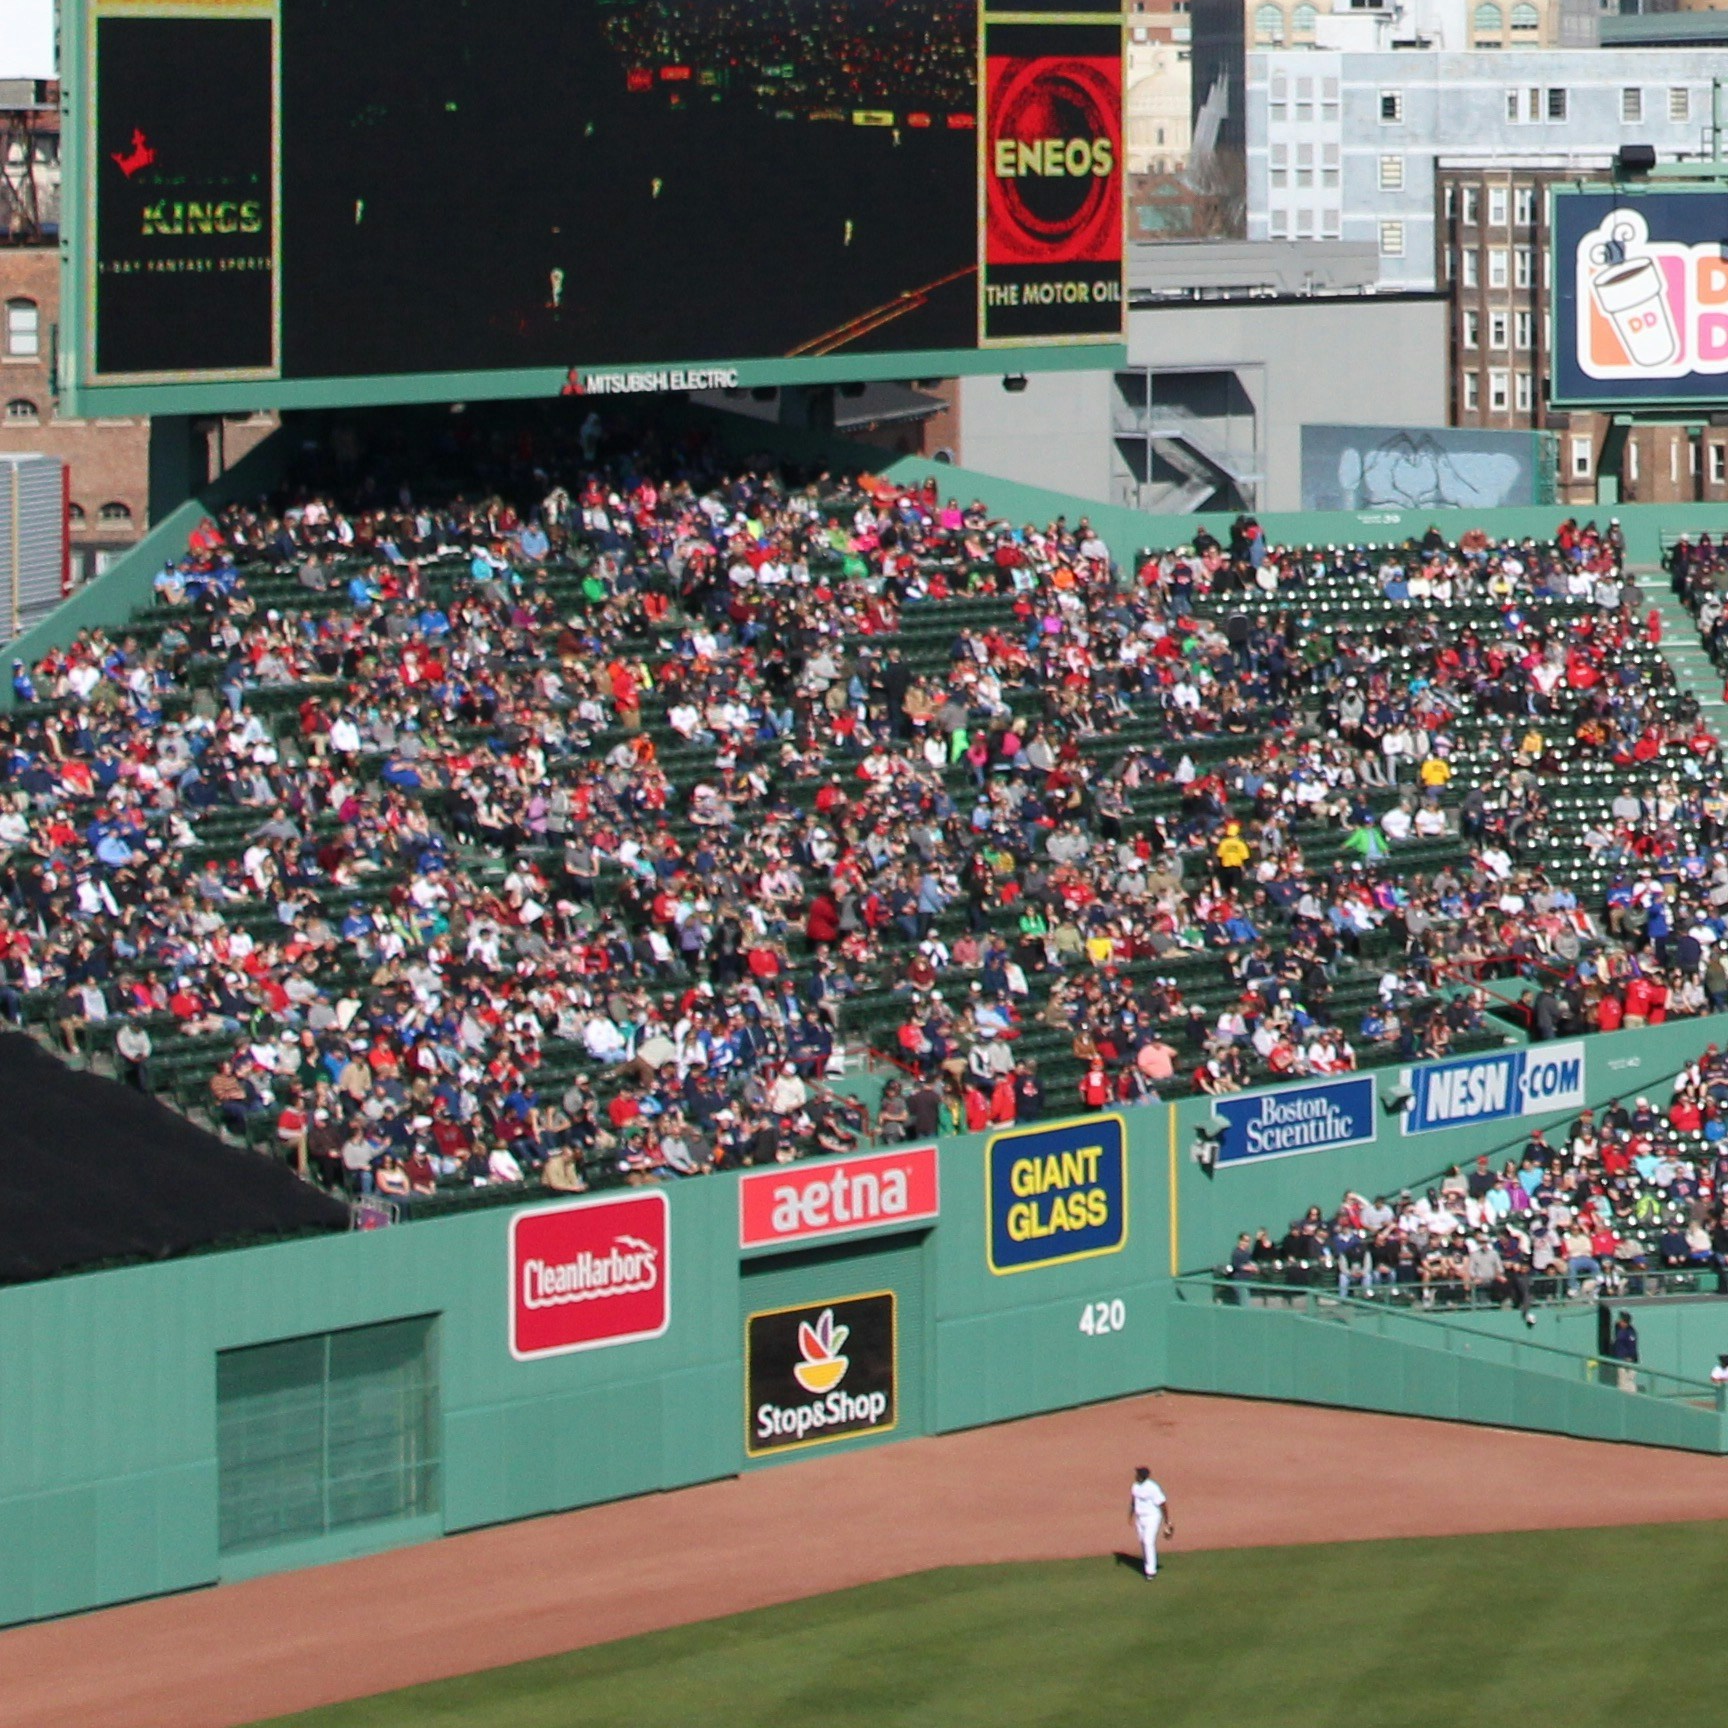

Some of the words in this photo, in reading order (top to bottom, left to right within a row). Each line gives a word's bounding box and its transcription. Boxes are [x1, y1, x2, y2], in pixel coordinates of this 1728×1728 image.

[995, 137, 1114, 178] ENEOS
[141, 198, 263, 236] KINGS
[987, 283, 1019, 306] THE
[1023, 280, 1090, 305] MOTOR
[1092, 280, 1122, 303] OIL
[1628, 310, 1658, 334] DD
[586, 372, 669, 395] MITSUBISHI
[670, 368, 740, 391] ELECTRIC
[1260, 1094, 1328, 1128] Boston
[1427, 1061, 1510, 1124] NESN
[1246, 1105, 1355, 1154] Scientific
[1010, 1145, 1104, 1198] GIANT
[771, 1166, 909, 1234] aetna
[1006, 1187, 1109, 1243] GLASS
[1077, 1297, 1127, 1337] 420
